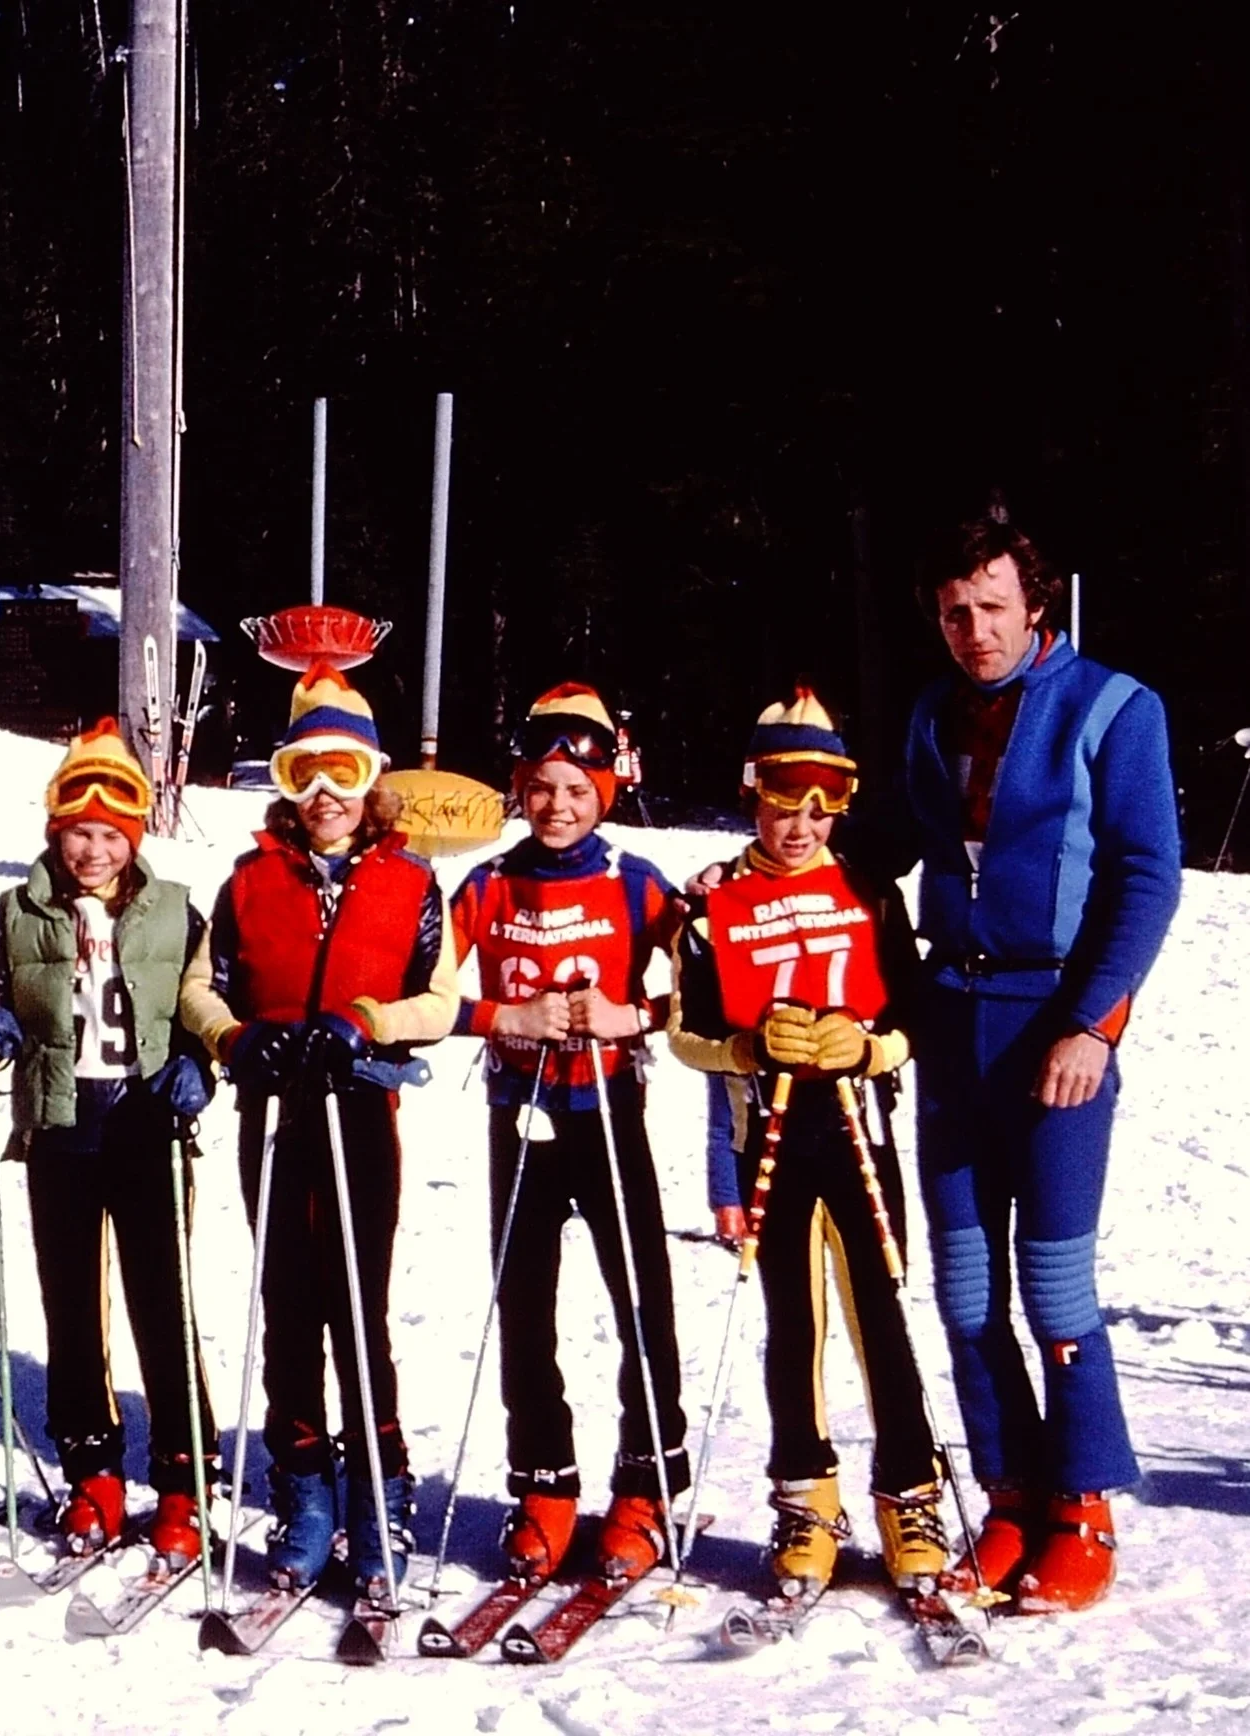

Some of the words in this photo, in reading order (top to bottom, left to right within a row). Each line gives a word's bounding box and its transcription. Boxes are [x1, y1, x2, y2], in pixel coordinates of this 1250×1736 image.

[4, 604, 71, 617] ELCOME
[728, 907, 869, 942] INTERNATIONAL
[751, 933, 852, 1010] 77
